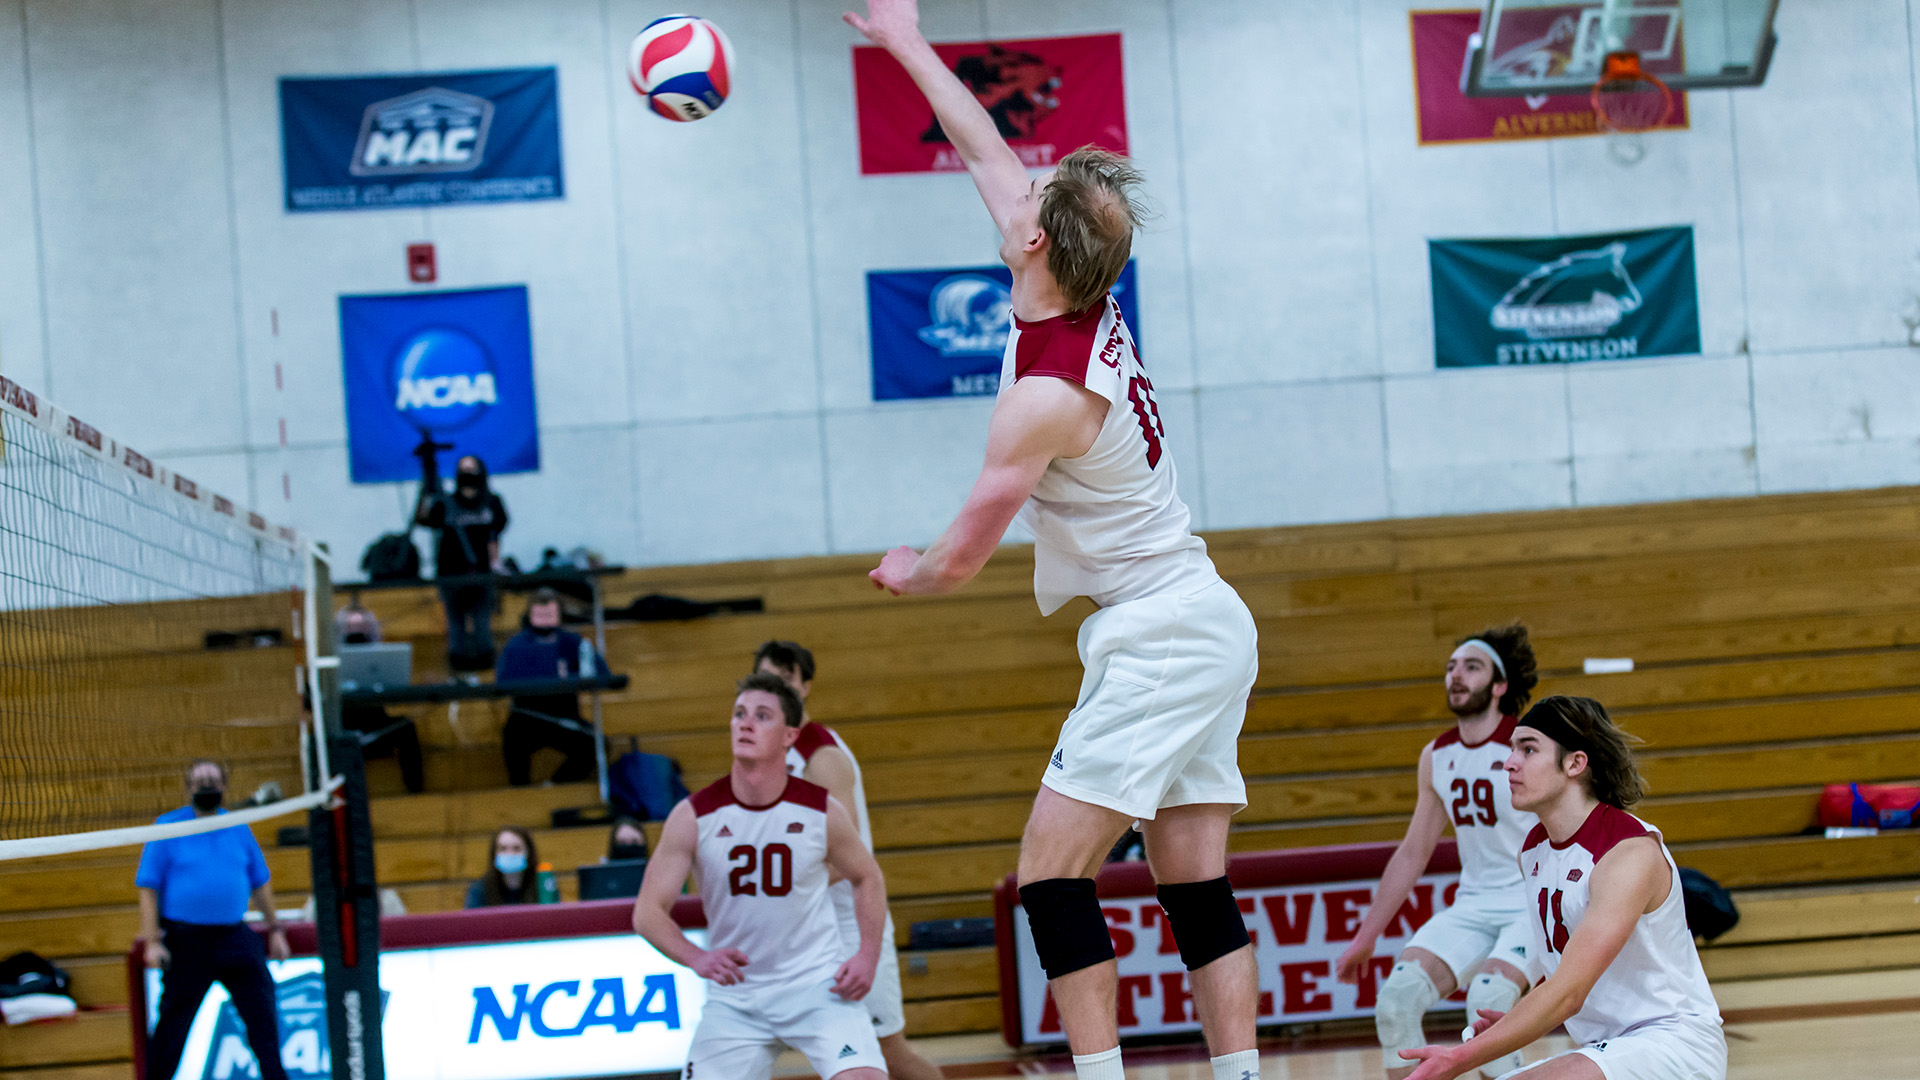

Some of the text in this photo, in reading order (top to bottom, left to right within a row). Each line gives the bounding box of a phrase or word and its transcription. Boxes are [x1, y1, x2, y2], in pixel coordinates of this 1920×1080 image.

[363, 126, 479, 167] MAC
[1493, 112, 1594, 137] ALVERNI
[1497, 336, 1638, 364] STEVENSON
[396, 373, 498, 410] NCAA
[1450, 778, 1499, 828] 29
[728, 843, 792, 897] 20
[467, 974, 681, 1044] NCAA
[211, 1028, 332, 1080] MA
